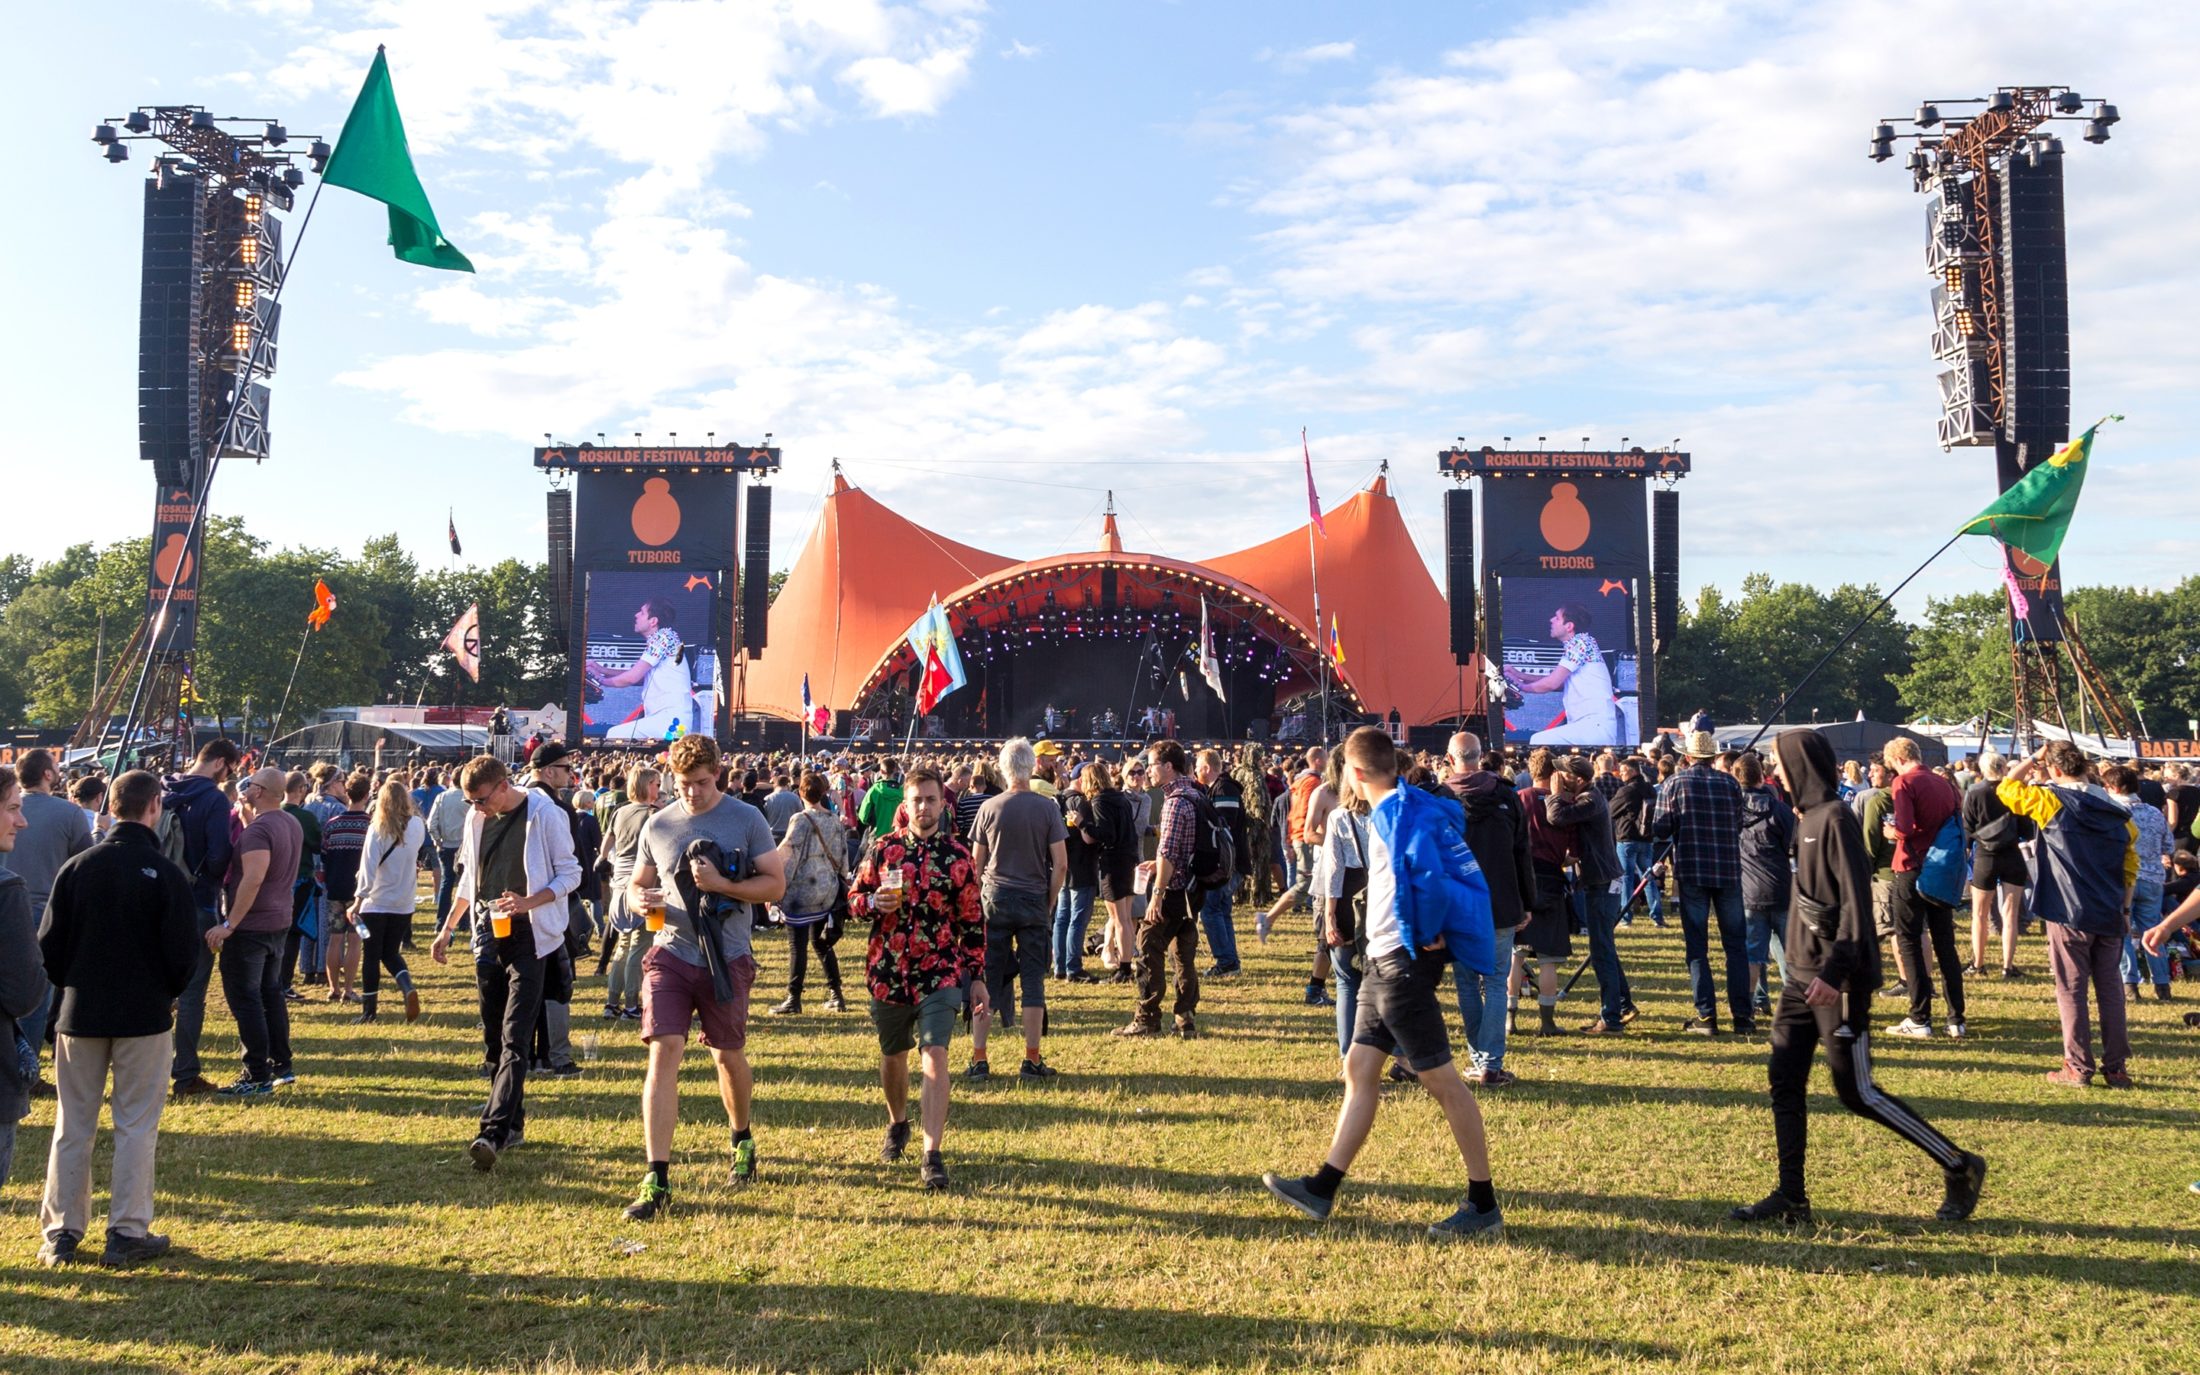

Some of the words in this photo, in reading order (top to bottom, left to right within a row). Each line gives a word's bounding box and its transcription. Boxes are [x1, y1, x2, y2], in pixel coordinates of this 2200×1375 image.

[578, 450, 641, 463] ROSKILDE
[643, 450, 702, 463] FESTIVAL
[704, 450, 735, 463] 2016
[1485, 454, 1549, 467] ROSKILDE
[1551, 454, 1611, 467] FESTIVAL
[1614, 455, 1646, 468] 2016
[157, 504, 198, 513] ROSKILD
[157, 514, 194, 523] FESTIV
[628, 550, 681, 563] TUBORG
[1539, 556, 1595, 569] TUBORG
[2018, 579, 2059, 590] UBORG
[150, 588, 195, 600] TUORG
[2140, 741, 2176, 757] BAR
[2178, 741, 2200, 757] EA
